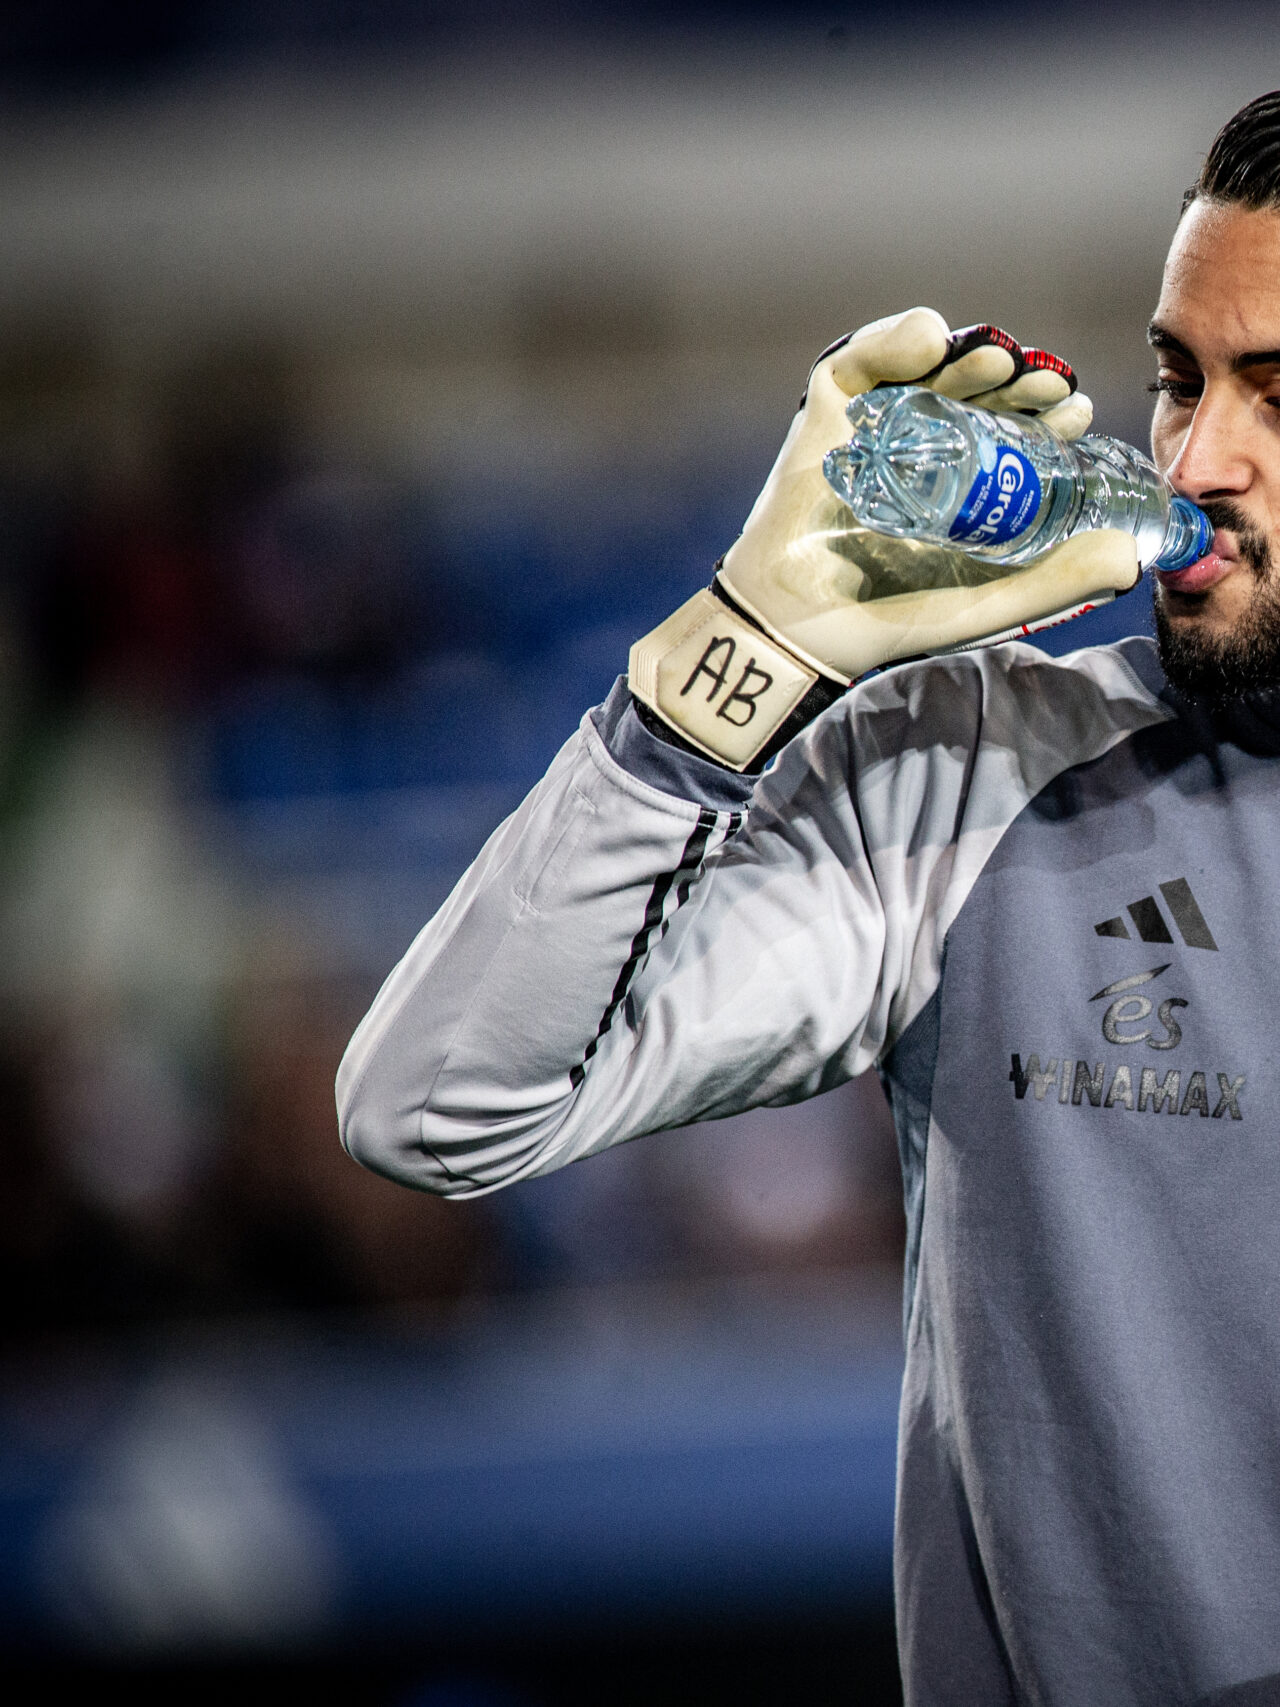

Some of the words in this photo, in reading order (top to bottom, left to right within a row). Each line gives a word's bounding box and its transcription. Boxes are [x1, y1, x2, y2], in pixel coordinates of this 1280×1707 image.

[965, 453, 1024, 542] Carola
[680, 636, 774, 727] AB
[1009, 1053, 1246, 1120] WINAMAX
